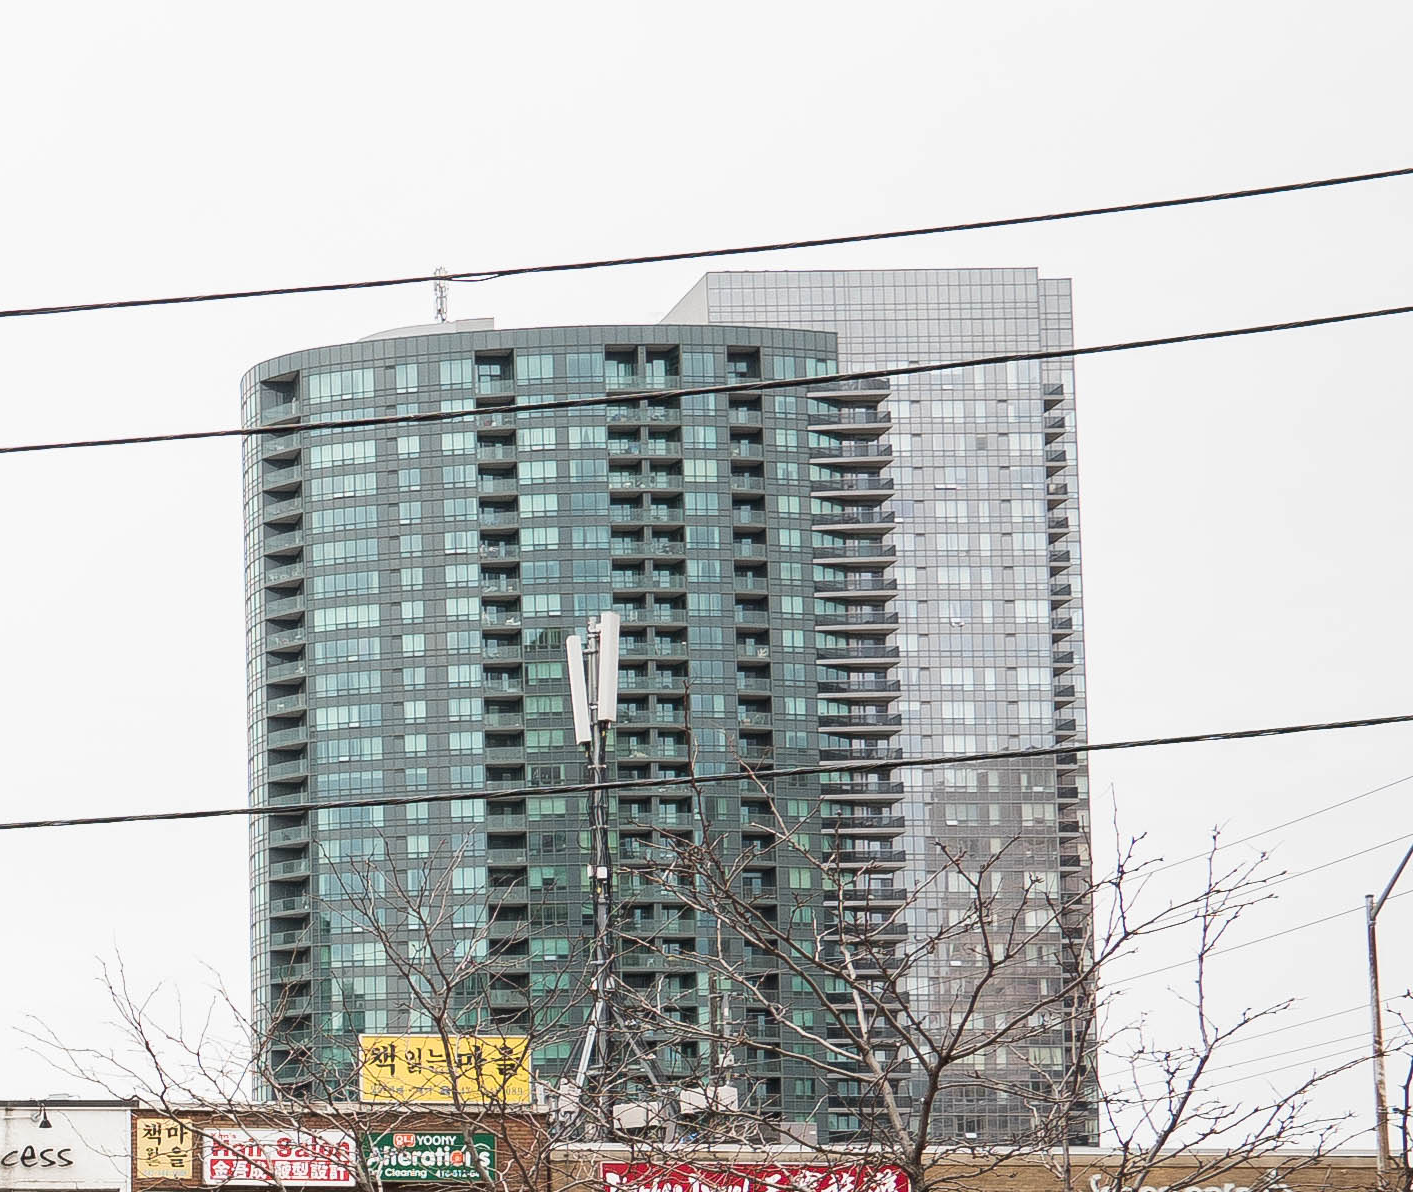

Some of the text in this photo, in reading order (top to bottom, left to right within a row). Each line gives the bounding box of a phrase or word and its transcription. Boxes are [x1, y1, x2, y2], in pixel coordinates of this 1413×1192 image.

[416, 1135, 457, 1146] YOONY
[212, 1137, 350, 1158] Hair Salon
[385, 1168, 428, 1179] Cleaning
